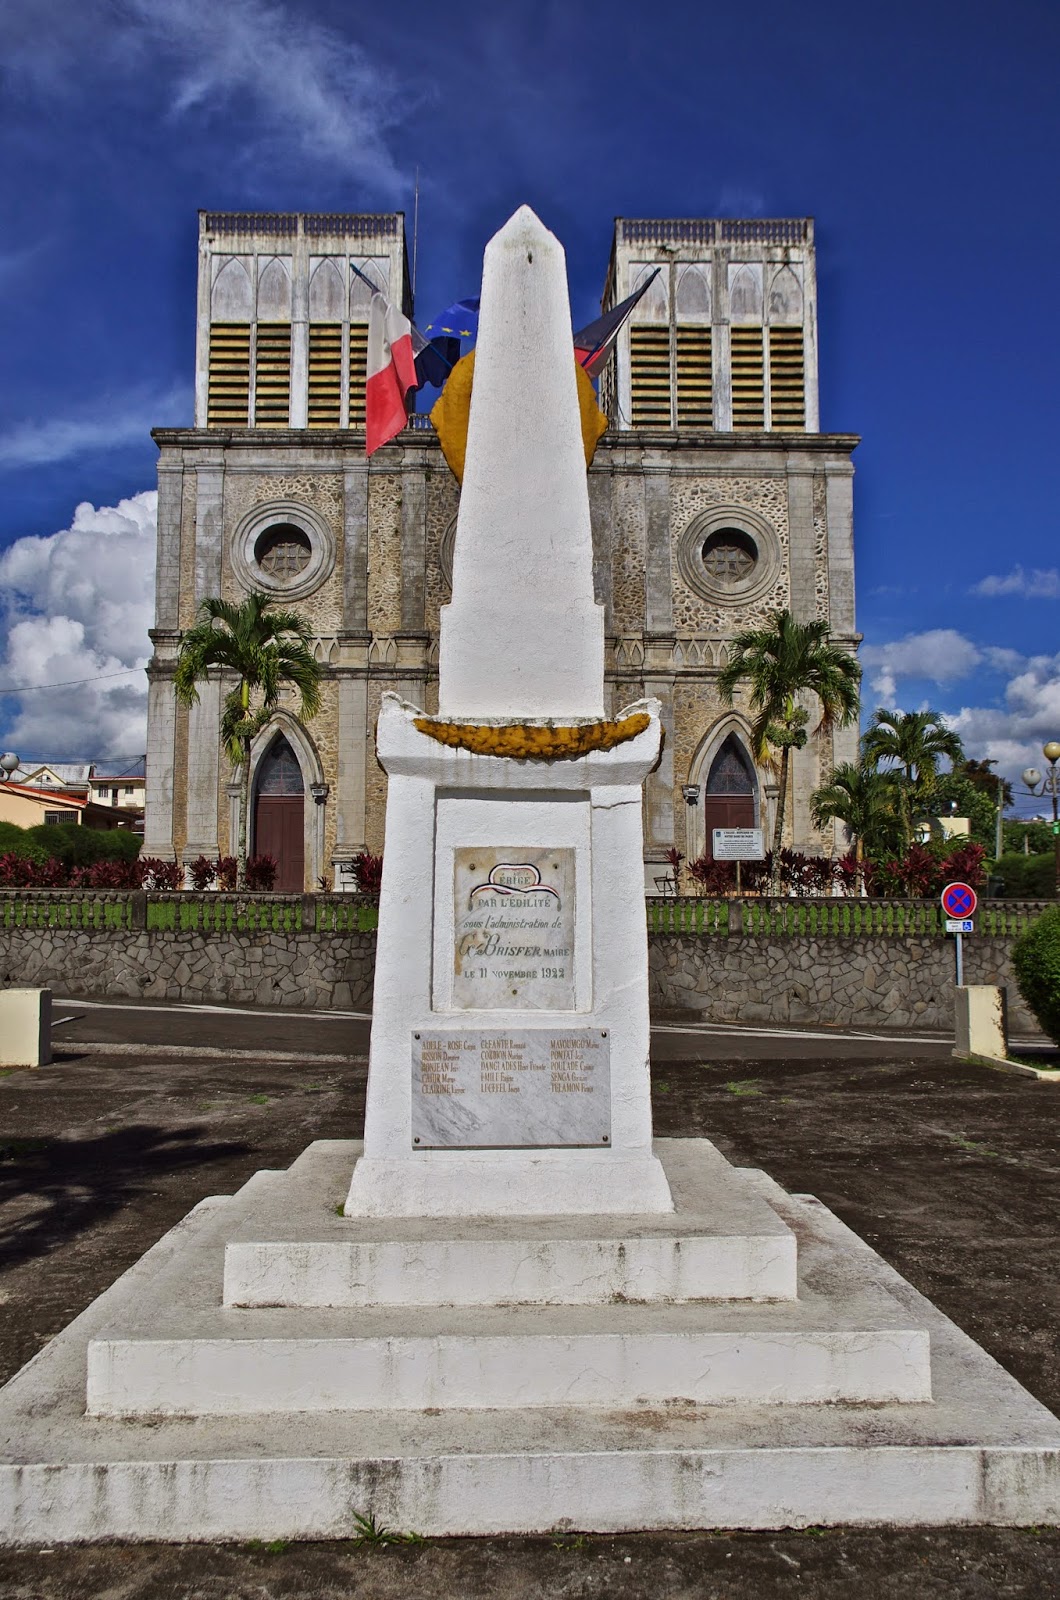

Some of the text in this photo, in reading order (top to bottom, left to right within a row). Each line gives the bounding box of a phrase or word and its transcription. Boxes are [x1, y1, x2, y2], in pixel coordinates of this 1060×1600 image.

[478, 898, 497, 907] PAR
[463, 915, 562, 929] sous l'administration de
[465, 967, 565, 979] LE 11 NOVEMBRE 1922
